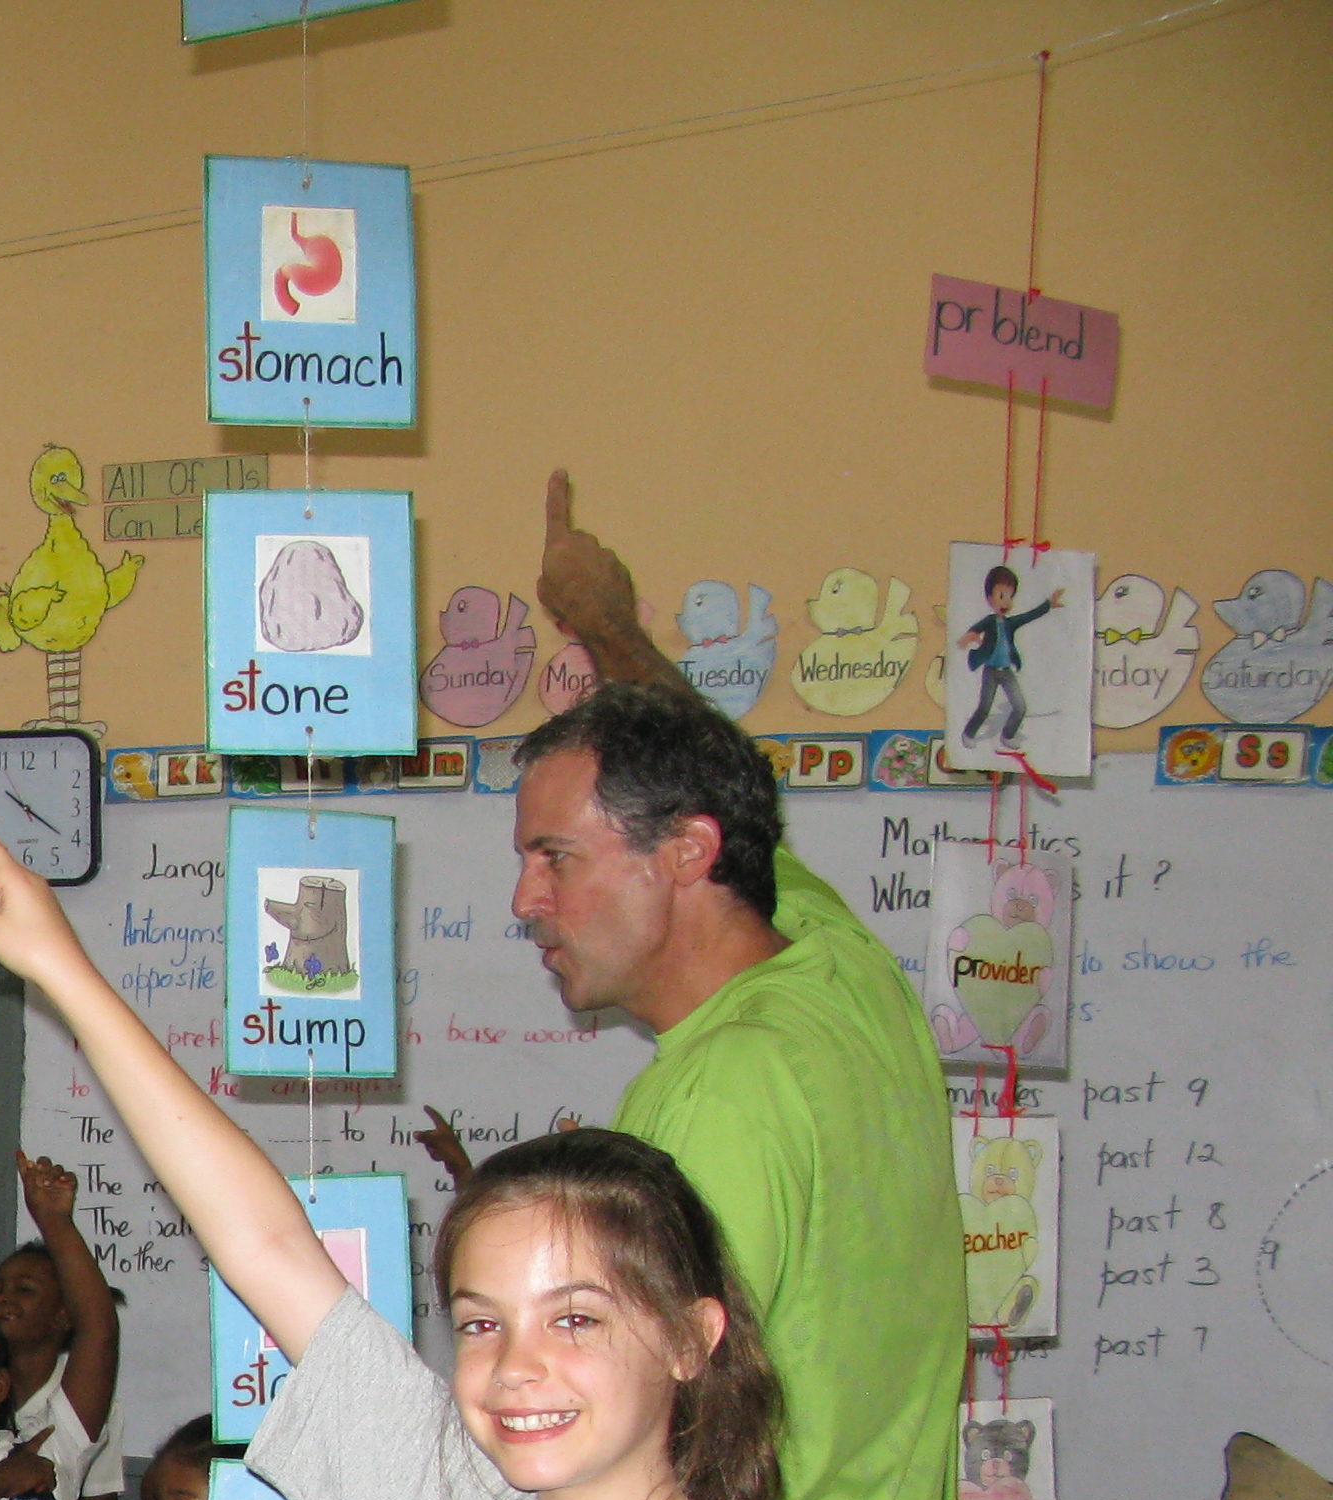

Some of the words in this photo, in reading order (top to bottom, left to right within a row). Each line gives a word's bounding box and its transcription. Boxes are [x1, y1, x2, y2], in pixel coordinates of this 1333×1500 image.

[933, 301, 983, 355] pr
[992, 288, 1084, 360] blend
[218, 321, 402, 387] stomach
[109, 459, 145, 499] All
[169, 461, 199, 495] Of
[225, 459, 258, 489] Us
[107, 507, 153, 538] Can
[222, 659, 349, 714] stone
[429, 659, 518, 701] Sunday
[677, 660, 769, 698] Tuesday
[799, 650, 910, 689] Wednesday
[1204, 660, 1333, 702] Saturday
[21, 751, 35, 771] 12
[71, 829, 81, 848] 4
[954, 950, 1041, 988] provider
[243, 998, 366, 1073] stump
[1083, 1071, 1164, 1120] past
[1188, 1077, 1208, 1107] 9
[71, 1115, 114, 1144] The
[1097, 1138, 1154, 1186] past
[1185, 1140, 1223, 1167] 12
[1107, 1194, 1181, 1249] past
[1207, 1202, 1226, 1230] 8
[94, 1243, 174, 1273] Mother
[1097, 1252, 1173, 1308] past
[1185, 1257, 1221, 1286] 3
[1093, 1326, 1164, 1374] past
[1192, 1326, 1208, 1353] 7
